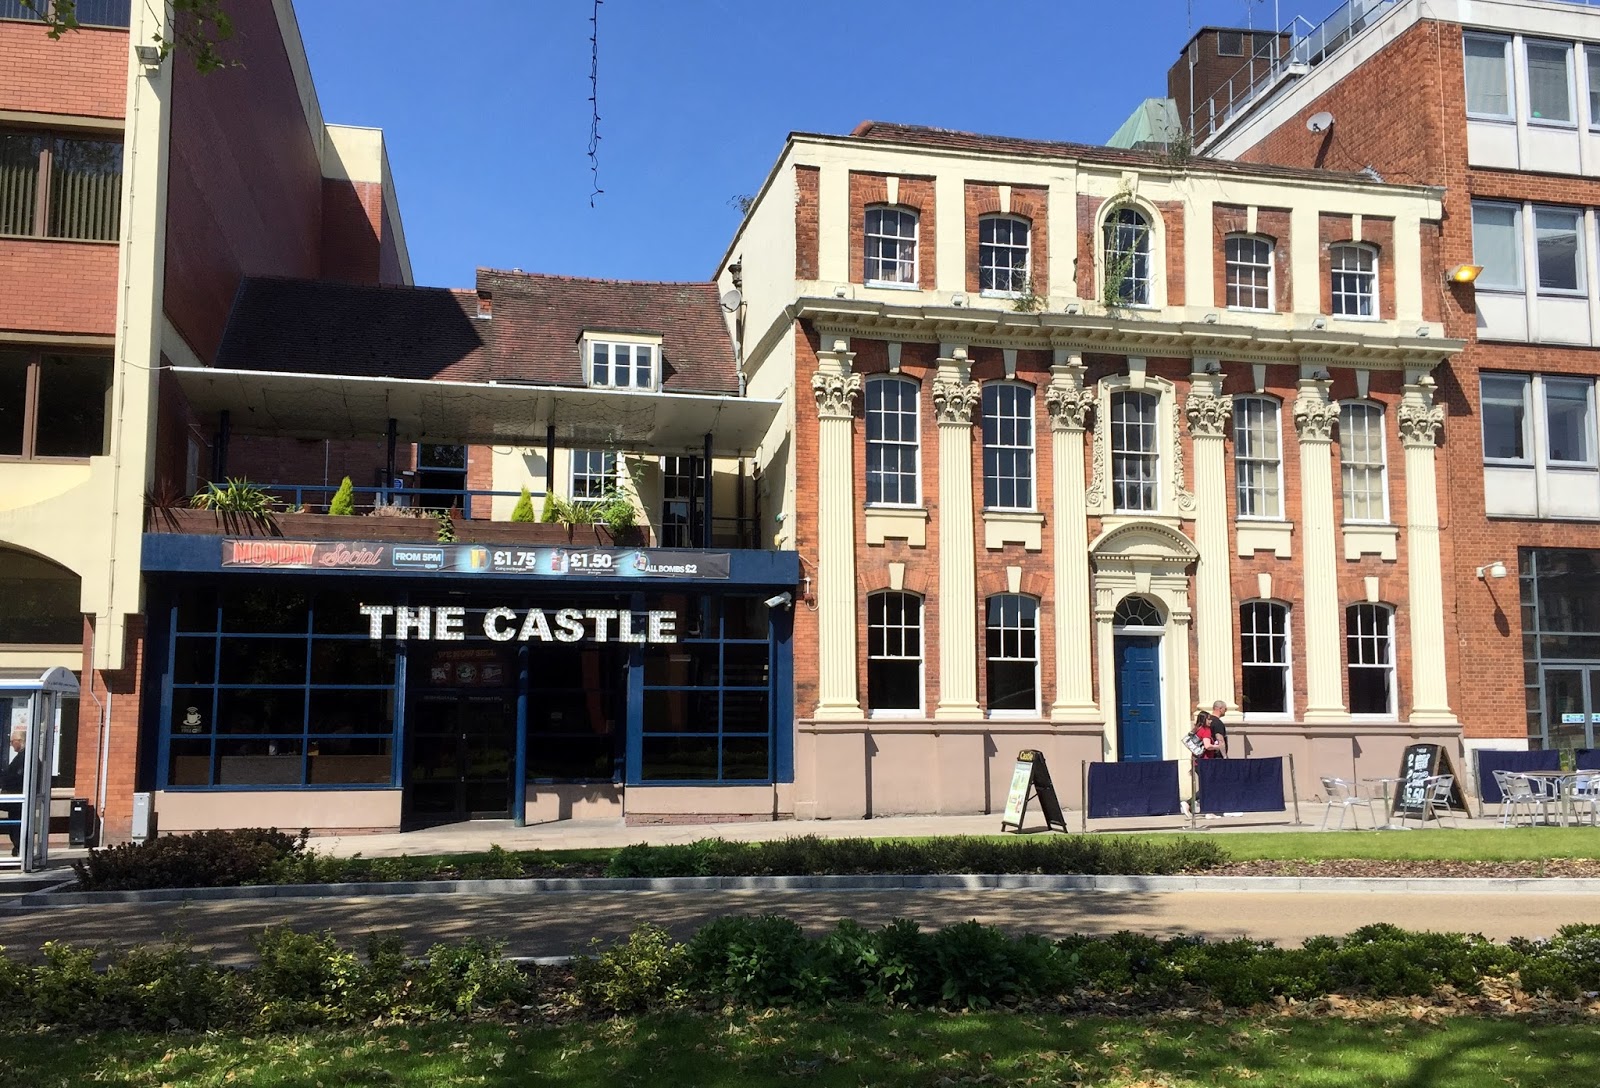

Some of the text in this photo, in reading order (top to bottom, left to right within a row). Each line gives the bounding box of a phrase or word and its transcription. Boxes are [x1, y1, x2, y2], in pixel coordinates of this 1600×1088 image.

[233, 542, 384, 566] MONDAY Social
[395, 552, 442, 562] FROM 5PM
[494, 551, 536, 566] £1.75
[570, 553, 612, 568] £1.50
[645, 564, 697, 573] ALL BOMBS £2
[360, 605, 677, 643] THE CASTLE
